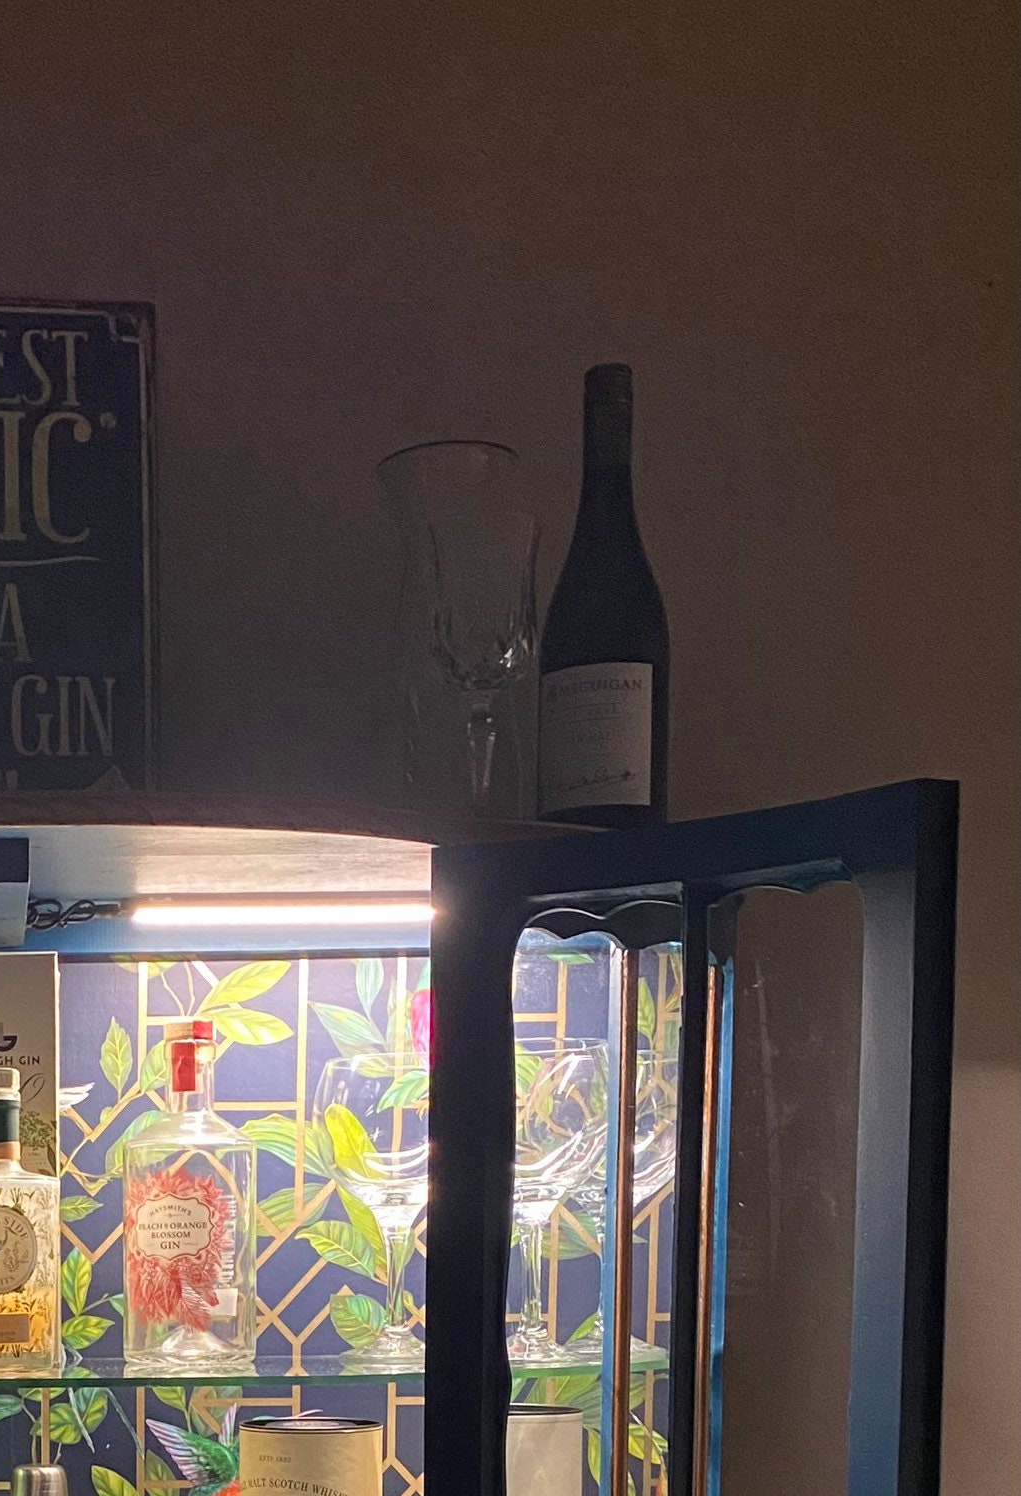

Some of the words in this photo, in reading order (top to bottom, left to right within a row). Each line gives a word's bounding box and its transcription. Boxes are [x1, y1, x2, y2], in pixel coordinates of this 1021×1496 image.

[12, 676, 115, 759] GIN
[19, 1055, 41, 1066] GIN
[138, 1222, 163, 1231] PEACH
[169, 1221, 208, 1230] ORANGE
[151, 1231, 191, 1239] BLOSSOM
[160, 1241, 181, 1250] GIN
[248, 1478, 266, 1488] MALT
[269, 1479, 309, 1492] SCOTCH
